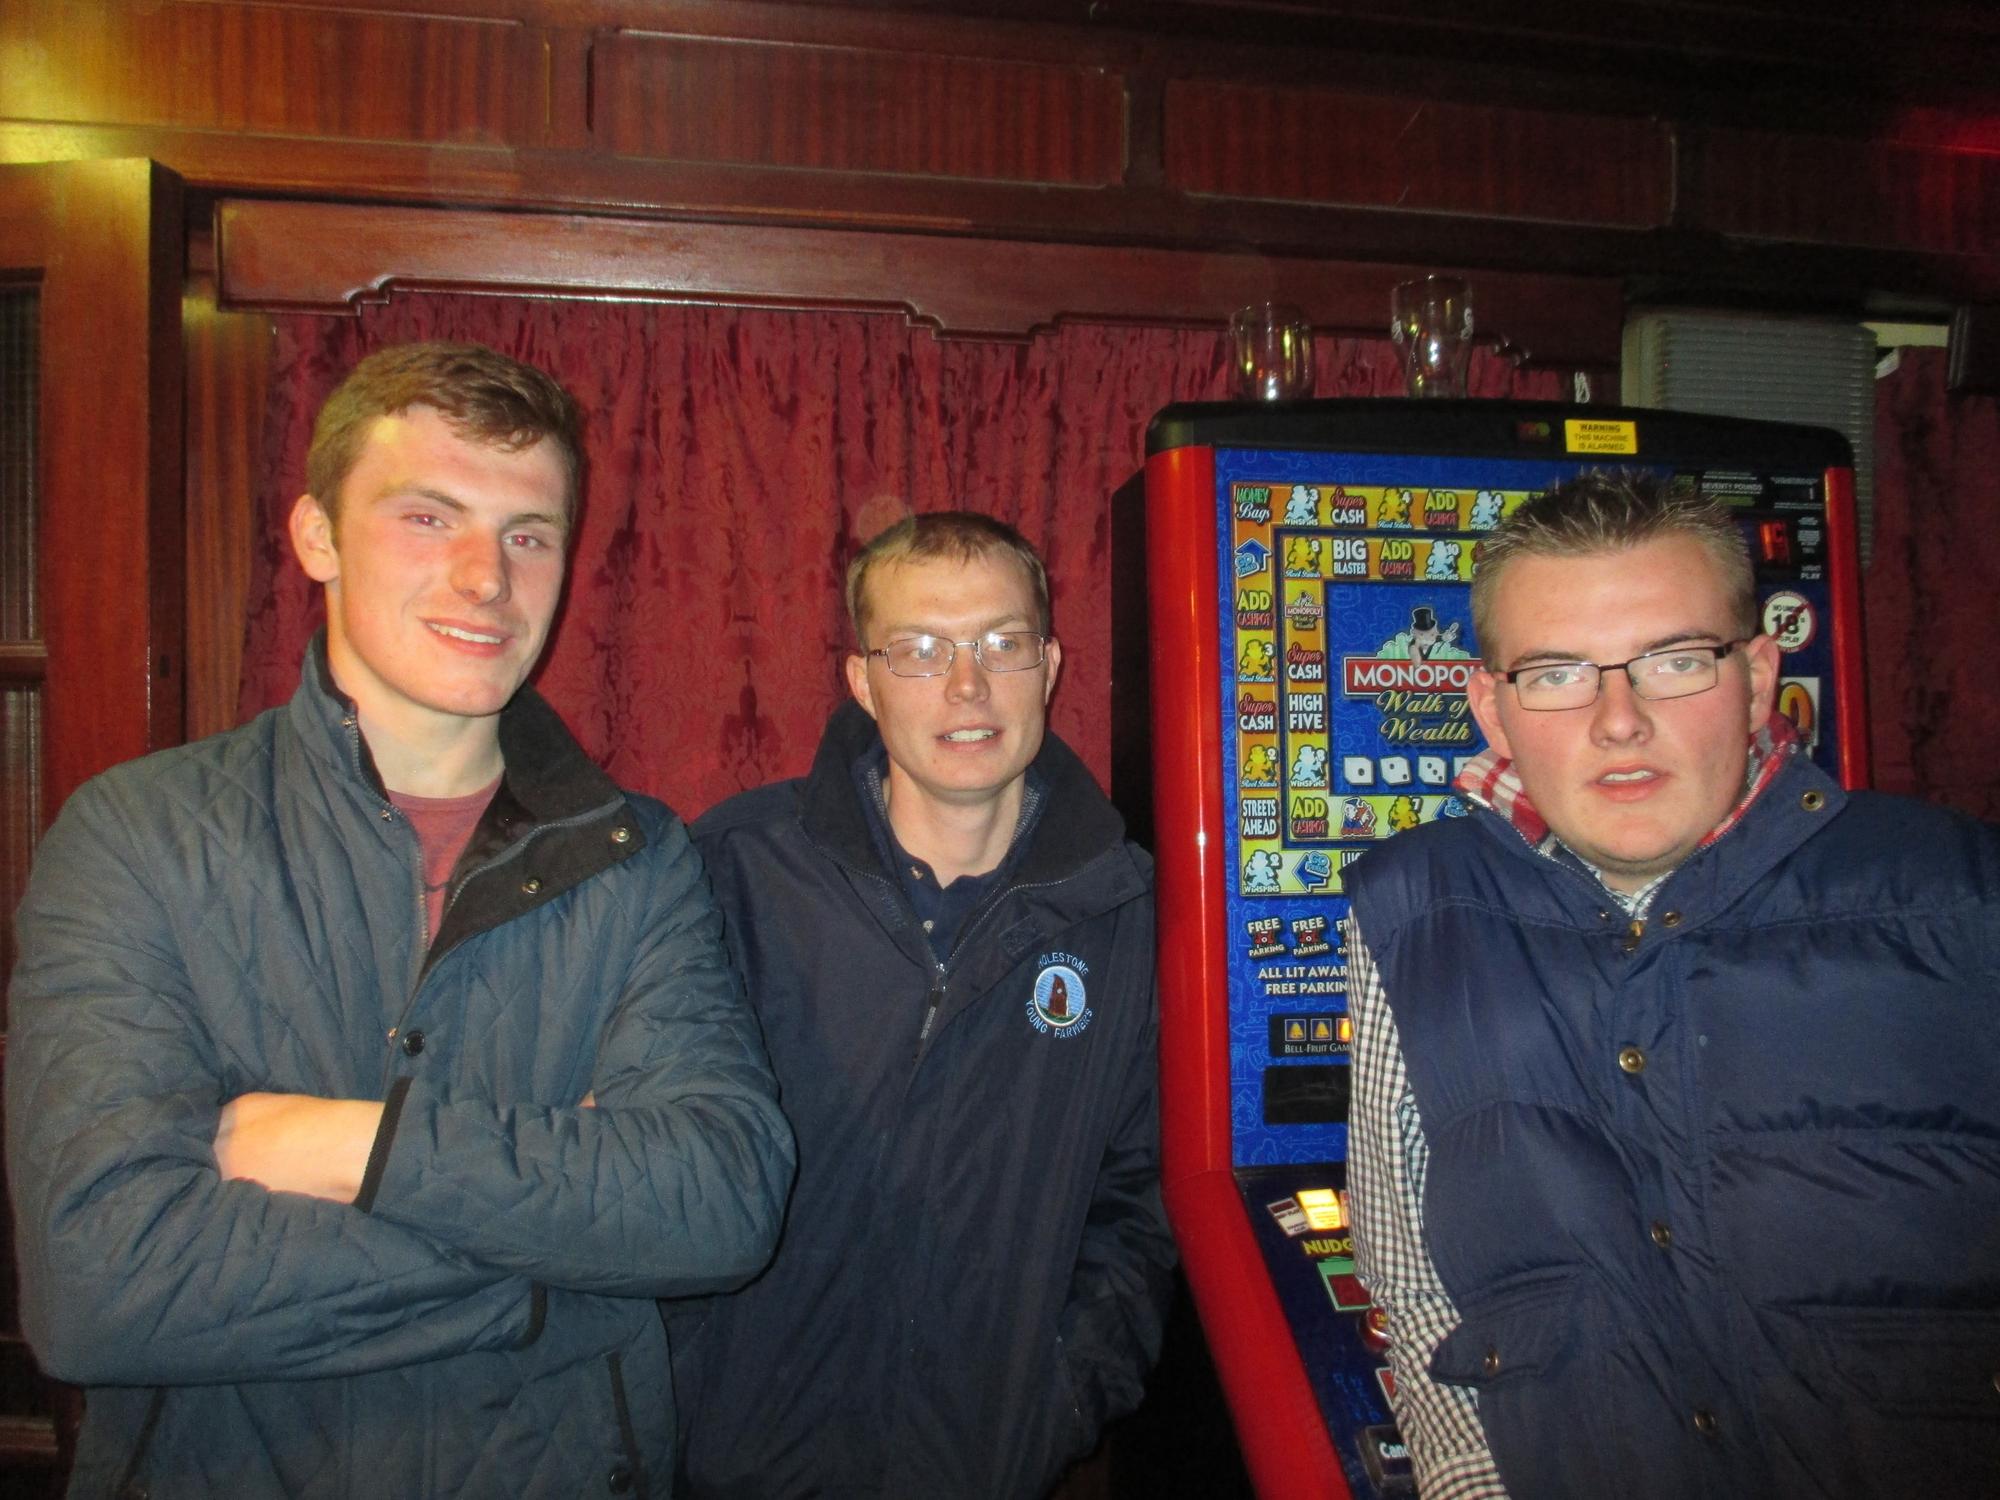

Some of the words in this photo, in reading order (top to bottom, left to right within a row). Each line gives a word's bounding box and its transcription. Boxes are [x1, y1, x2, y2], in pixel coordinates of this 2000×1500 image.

[1580, 424, 1621, 432] WARNING
[1425, 490, 1456, 510] ADD
[1237, 502, 1270, 522] Bags
[1332, 508, 1365, 523] CASH
[1333, 539, 1366, 560] BIG
[1380, 540, 1412, 560] ADD
[1333, 562, 1366, 574] BLASTER
[1237, 591, 1270, 611] ADD
[1287, 607, 1321, 615] MONOPOLY
[1288, 664, 1321, 679] CASH
[1240, 695, 1273, 715] Super
[1289, 694, 1323, 711] HIGH
[1376, 690, 1444, 713] Walk
[1240, 715, 1273, 730] CASH
[1290, 713, 1323, 729] FIVE
[1380, 718, 1471, 741] Wealth
[1242, 799, 1276, 817] STREETS
[1292, 799, 1326, 818] ADD
[1243, 818, 1277, 836] AHEAD
[1342, 852, 1363, 867] LU
[1247, 918, 1280, 934] FREE
[1292, 917, 1324, 933] FREE
[1248, 944, 1285, 957] PARKING
[1293, 943, 1329, 956] PARKING
[1258, 967, 1283, 979] ALL
[1286, 967, 1305, 978] LIT
[1265, 982, 1296, 995] FREE
[1025, 999, 1049, 1034] YOUNG
[1054, 1008, 1093, 1039] FARMERS
